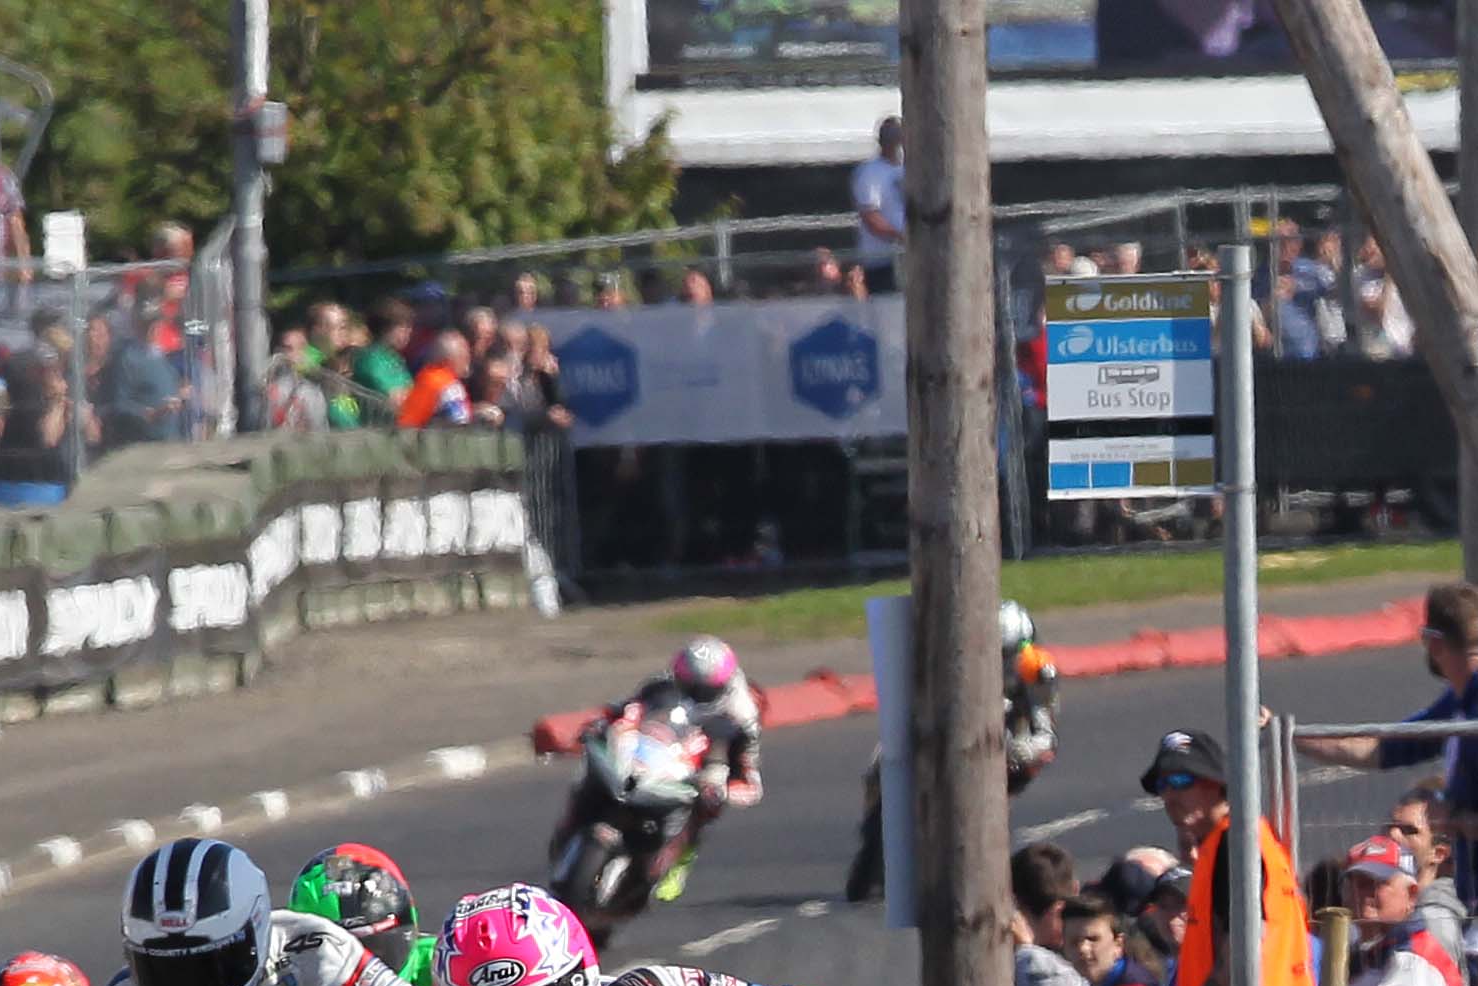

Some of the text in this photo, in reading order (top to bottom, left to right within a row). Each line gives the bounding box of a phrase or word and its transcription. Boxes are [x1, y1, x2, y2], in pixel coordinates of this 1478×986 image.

[1096, 333, 1198, 356] Ulsterbus
[1087, 388, 1171, 411] Bus Stop
[474, 963, 518, 986] Arai
